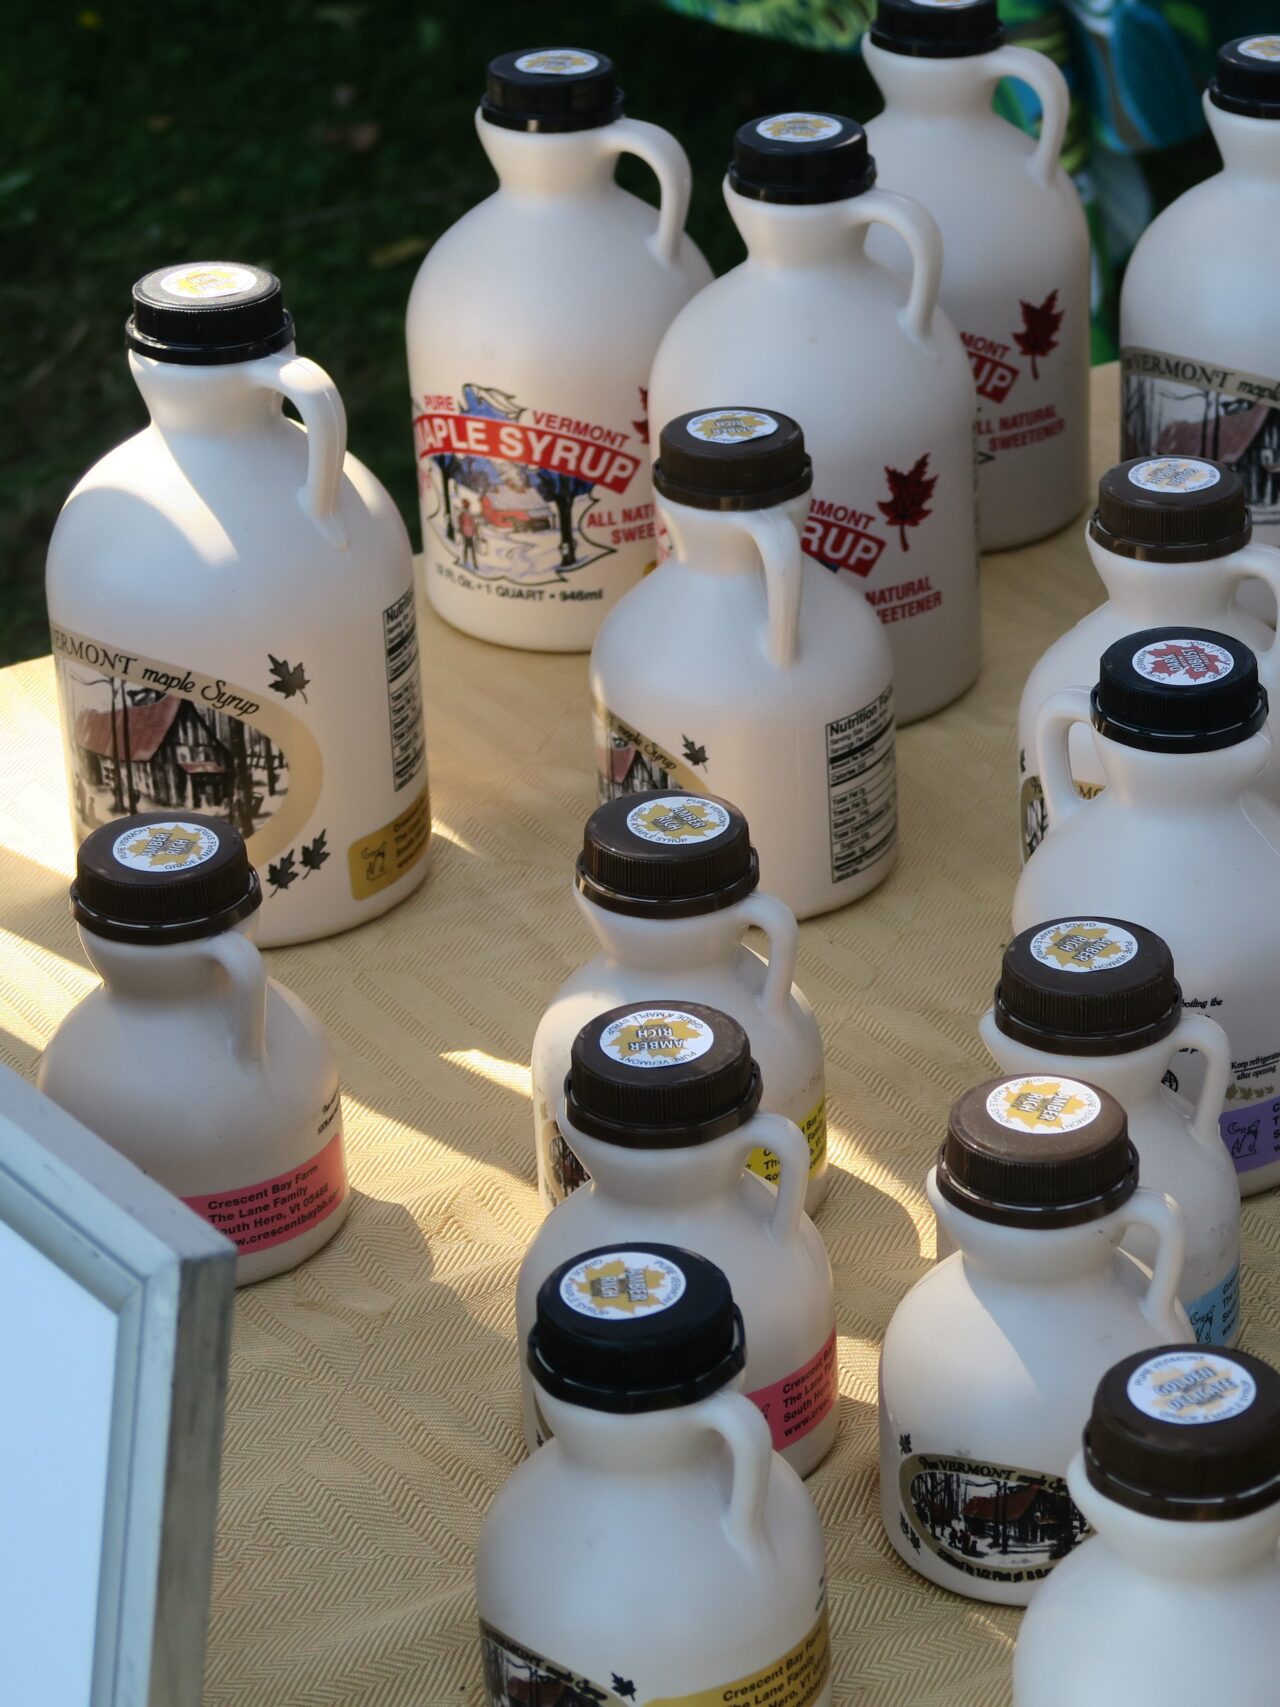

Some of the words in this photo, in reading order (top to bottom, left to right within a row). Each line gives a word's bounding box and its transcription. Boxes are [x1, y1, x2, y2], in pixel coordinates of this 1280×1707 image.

[1133, 355, 1234, 388] VERMONT
[532, 410, 630, 448] VERMONT
[1000, 404, 1057, 430] NATURAL
[988, 418, 1066, 451] SWEETENER
[499, 426, 636, 483] SYRUP
[587, 509, 616, 528] ALL
[496, 585, 544, 600] QUART
[865, 576, 933, 607] NATURAL
[55, 629, 139, 677] ERMONT
[142, 664, 196, 695] maple
[201, 679, 260, 715] Syrup
[1161, 654, 1183, 670] DARK
[1182, 650, 1208, 672] ROBUST
[829, 705, 878, 737] Nutrition
[643, 741, 677, 771] Syrup
[655, 815, 681, 830] RICH
[672, 806, 706, 829] AMBER
[141, 832, 172, 857] AMBER
[166, 838, 192, 856] RICH
[1058, 935, 1089, 952] RICH
[1072, 938, 1112, 961] AMBER
[630, 1039, 685, 1050] AMBER
[637, 1028, 672, 1038] RICH
[1231, 1060, 1248, 1070] Keep
[1018, 1092, 1043, 1112] RICH
[1037, 1093, 1073, 1121] AMBER
[208, 1188, 269, 1210] Crescent
[271, 1179, 293, 1195] Bay
[295, 1164, 318, 1184] Farm
[209, 1212, 235, 1223] The
[239, 1204, 270, 1218] Lane
[273, 1184, 308, 1207] Family
[221, 1222, 250, 1235] outh
[253, 1212, 287, 1228] Hero,
[627, 1268, 648, 1302] AMBER
[1155, 1366, 1216, 1396] GOLDEN
[1167, 1377, 1238, 1410] DELICATE
[939, 1459, 1015, 1480] VERMONT
